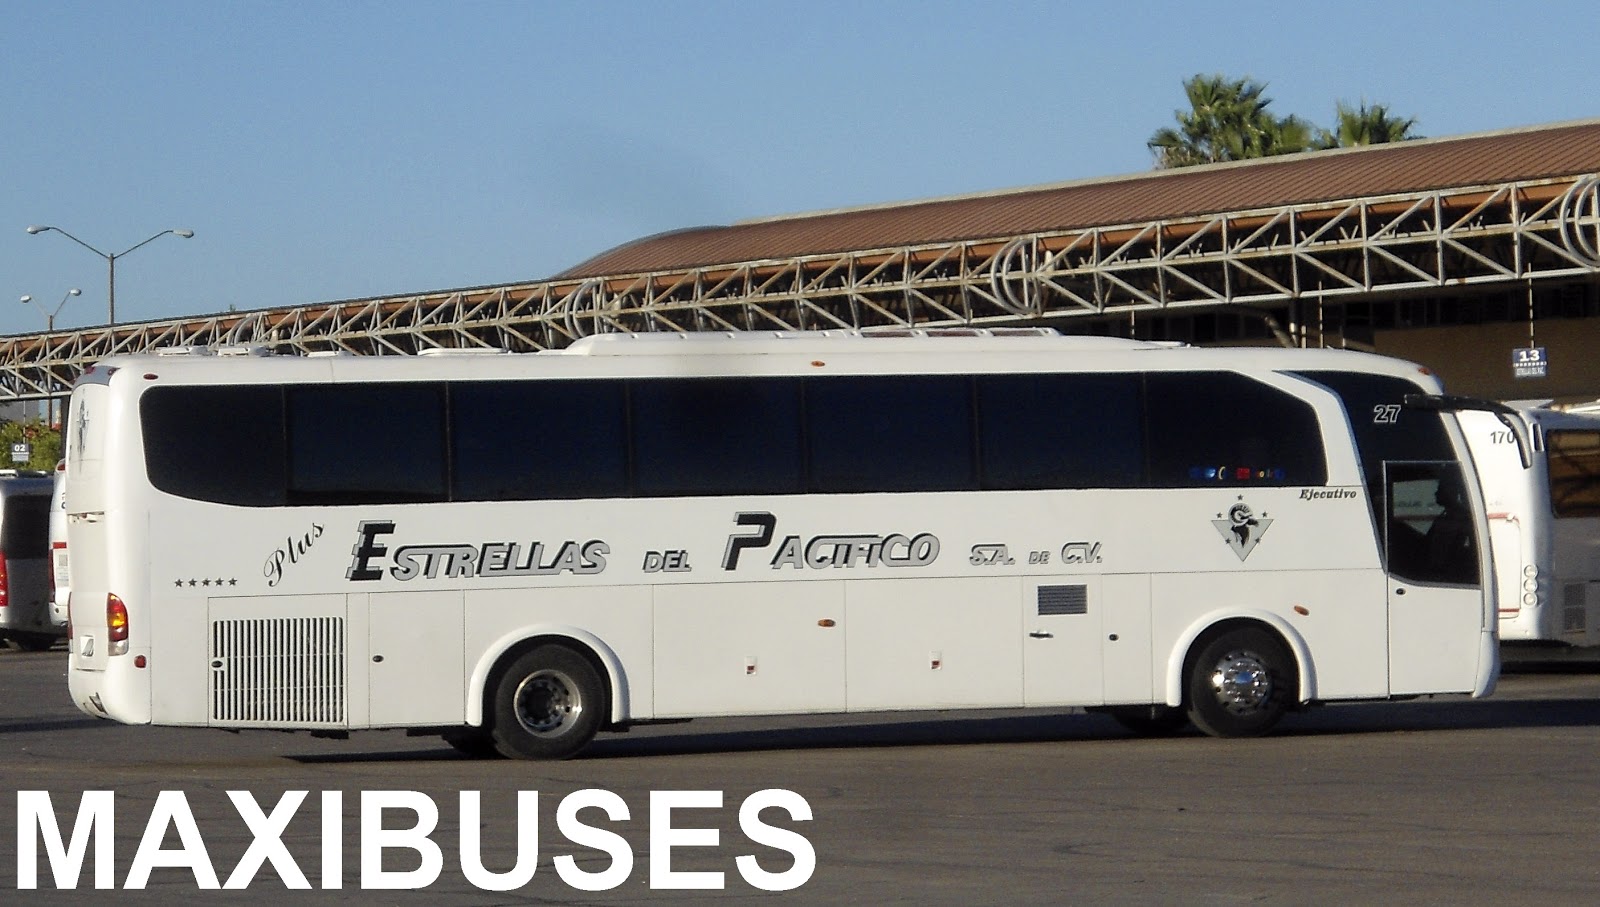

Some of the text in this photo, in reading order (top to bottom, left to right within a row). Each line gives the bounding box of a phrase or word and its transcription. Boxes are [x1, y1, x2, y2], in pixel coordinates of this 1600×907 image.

[1519, 349, 1540, 361] 13
[1373, 404, 1401, 423] 27
[1489, 430, 1516, 445] 170
[14, 444, 26, 452] 02
[1299, 488, 1357, 501] Ejecutivo
[345, 510, 1103, 582] ESTRELLAS DEL PACIFICO S.A. DE C.V.
[263, 522, 325, 588] Plus
